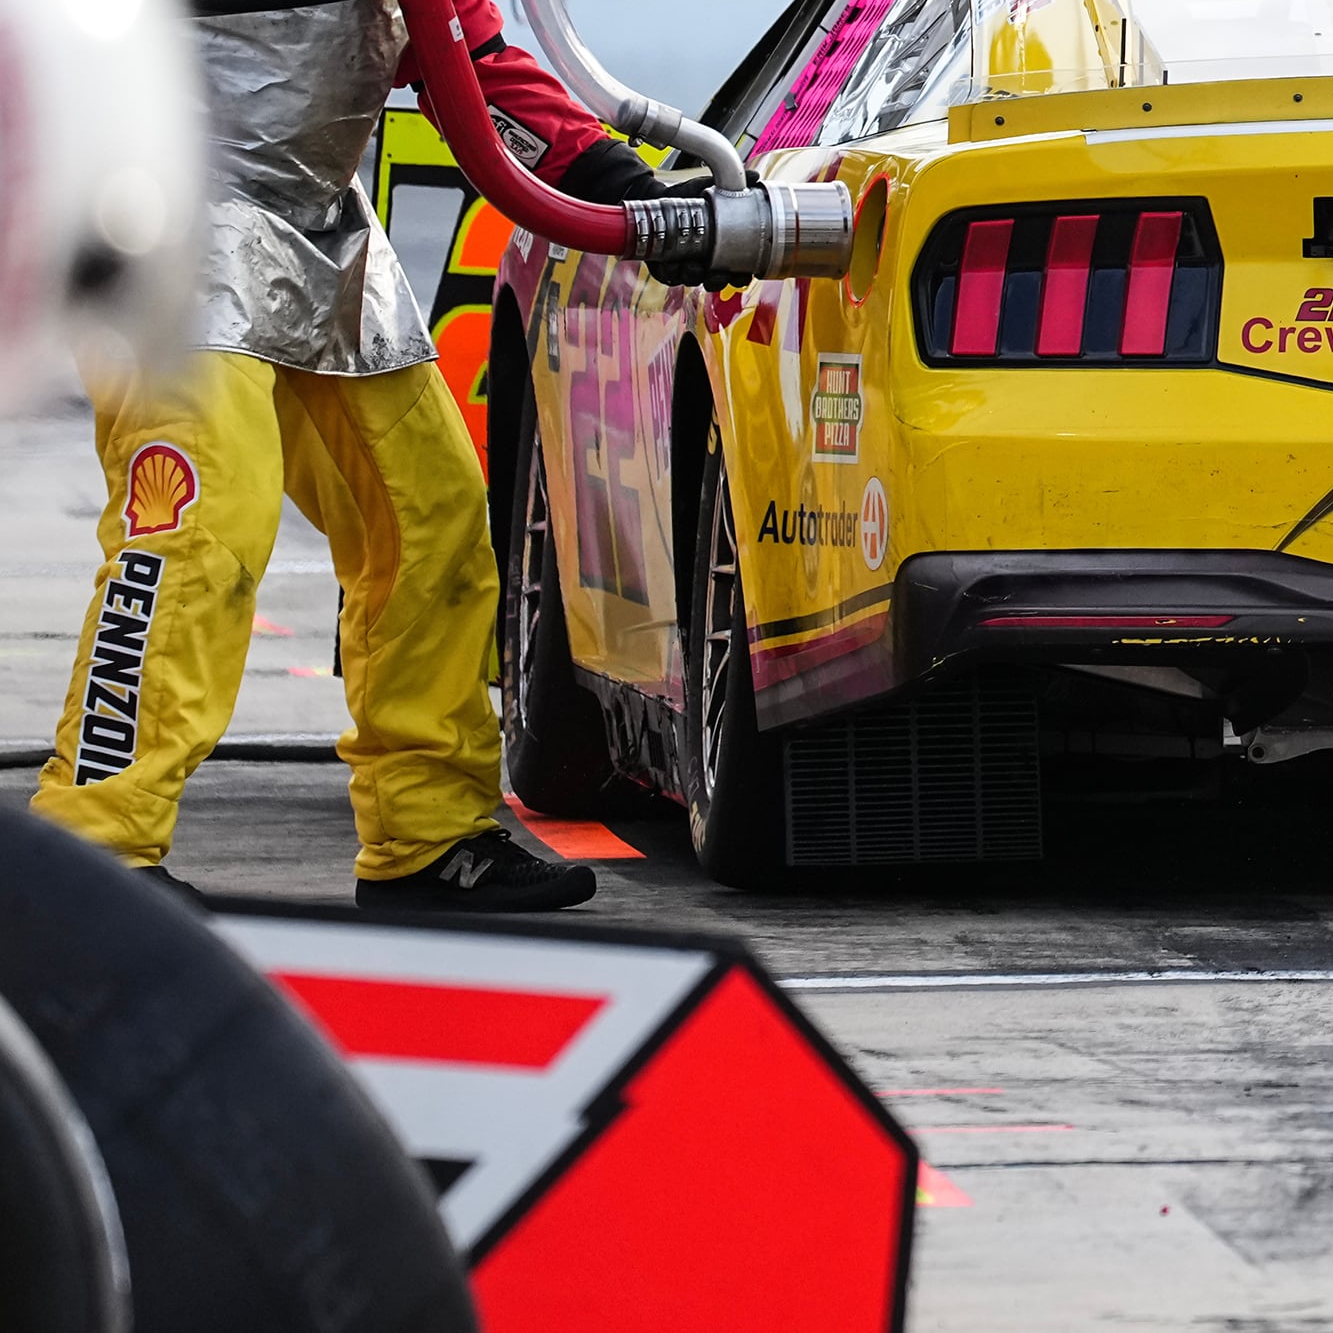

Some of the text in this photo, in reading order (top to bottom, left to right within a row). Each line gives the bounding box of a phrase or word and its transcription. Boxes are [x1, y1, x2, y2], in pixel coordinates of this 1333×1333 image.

[826, 370, 851, 393] HUNT
[815, 397, 860, 420] BROTHERS
[824, 422, 850, 446] PIZZA
[757, 499, 858, 548] Autotrader
[76, 550, 163, 787] PENNZOIL
